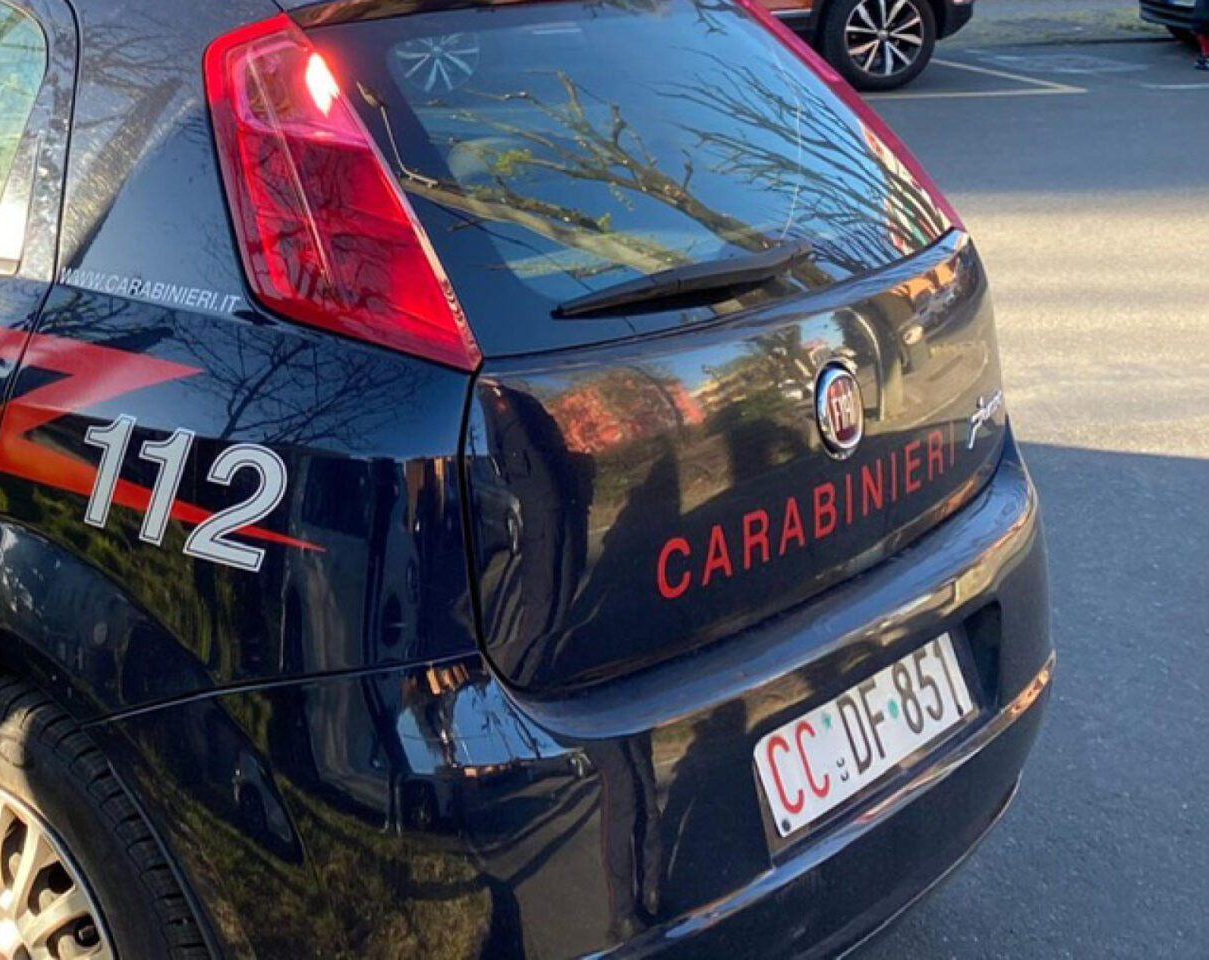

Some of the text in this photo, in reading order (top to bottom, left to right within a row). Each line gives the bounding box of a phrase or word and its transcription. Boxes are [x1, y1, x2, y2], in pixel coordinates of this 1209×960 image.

[60, 267, 241, 312] WWW.CARABINIERI.IT
[83, 413, 287, 572] 112
[658, 424, 955, 599] CARABINIERI
